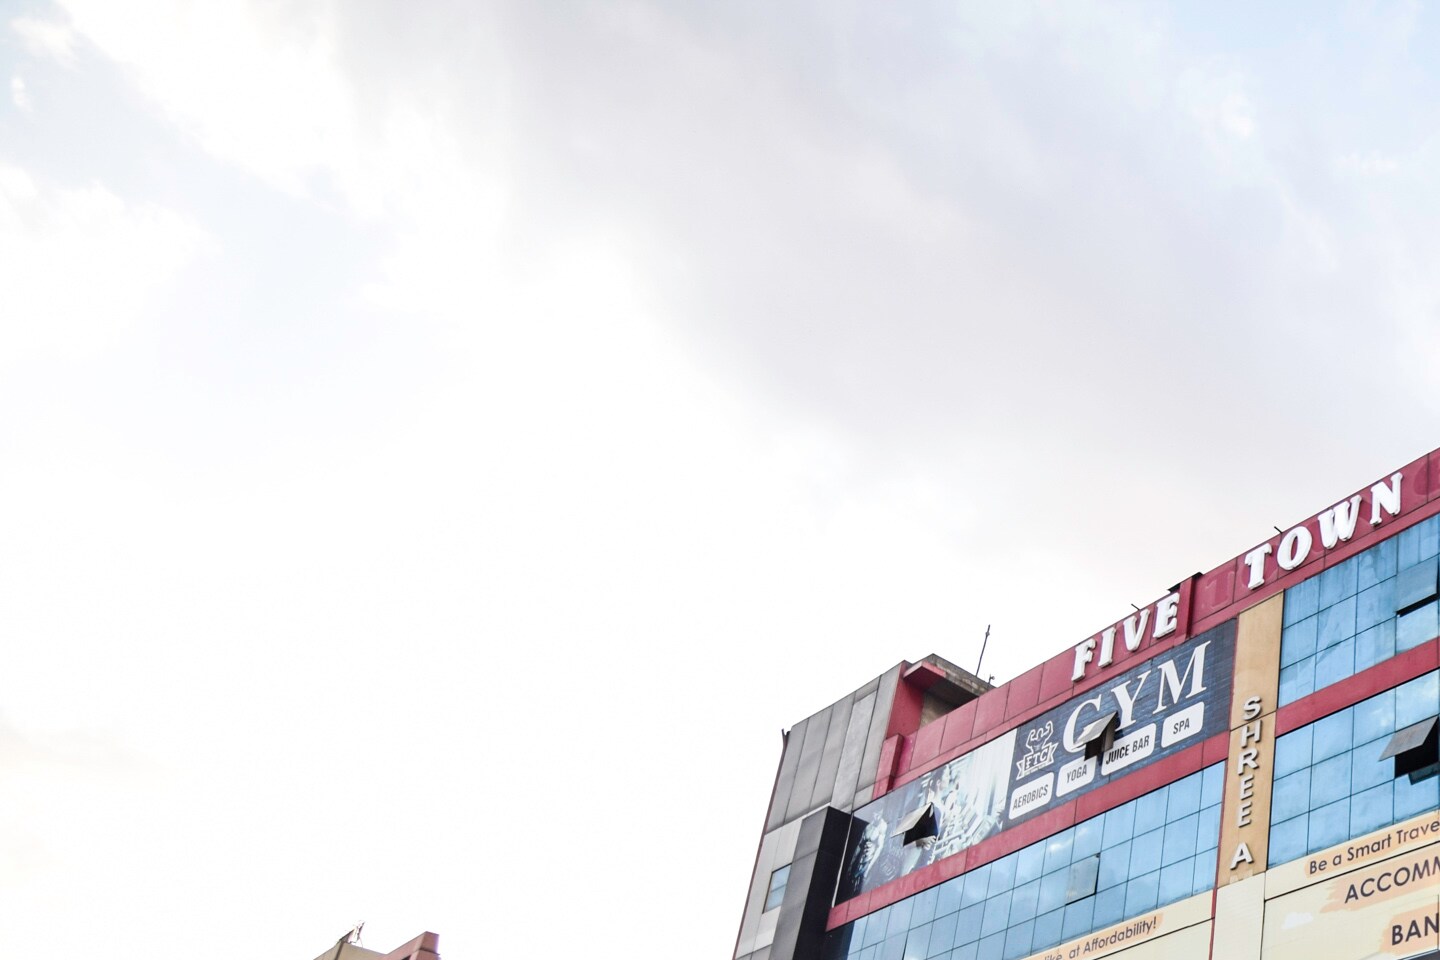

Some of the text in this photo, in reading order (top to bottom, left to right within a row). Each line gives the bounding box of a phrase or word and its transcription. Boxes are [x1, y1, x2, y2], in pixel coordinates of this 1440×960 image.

[1071, 593, 1180, 681] FIVE
[1245, 473, 1403, 590] TOWN
[1063, 641, 1211, 753] GYM
[1173, 717, 1190, 735] SPA
[1105, 734, 1150, 765] JUICE BAR
[1066, 764, 1087, 783] YOGA
[1230, 696, 1262, 870] SHREE A
[1012, 784, 1049, 811] AEROBICS
[1309, 859, 1327, 875] Be
[1332, 854, 1342, 867] a
[1347, 833, 1392, 861] Smart
[1068, 946, 1080, 960] at
[1083, 915, 1157, 954] Affordability!
